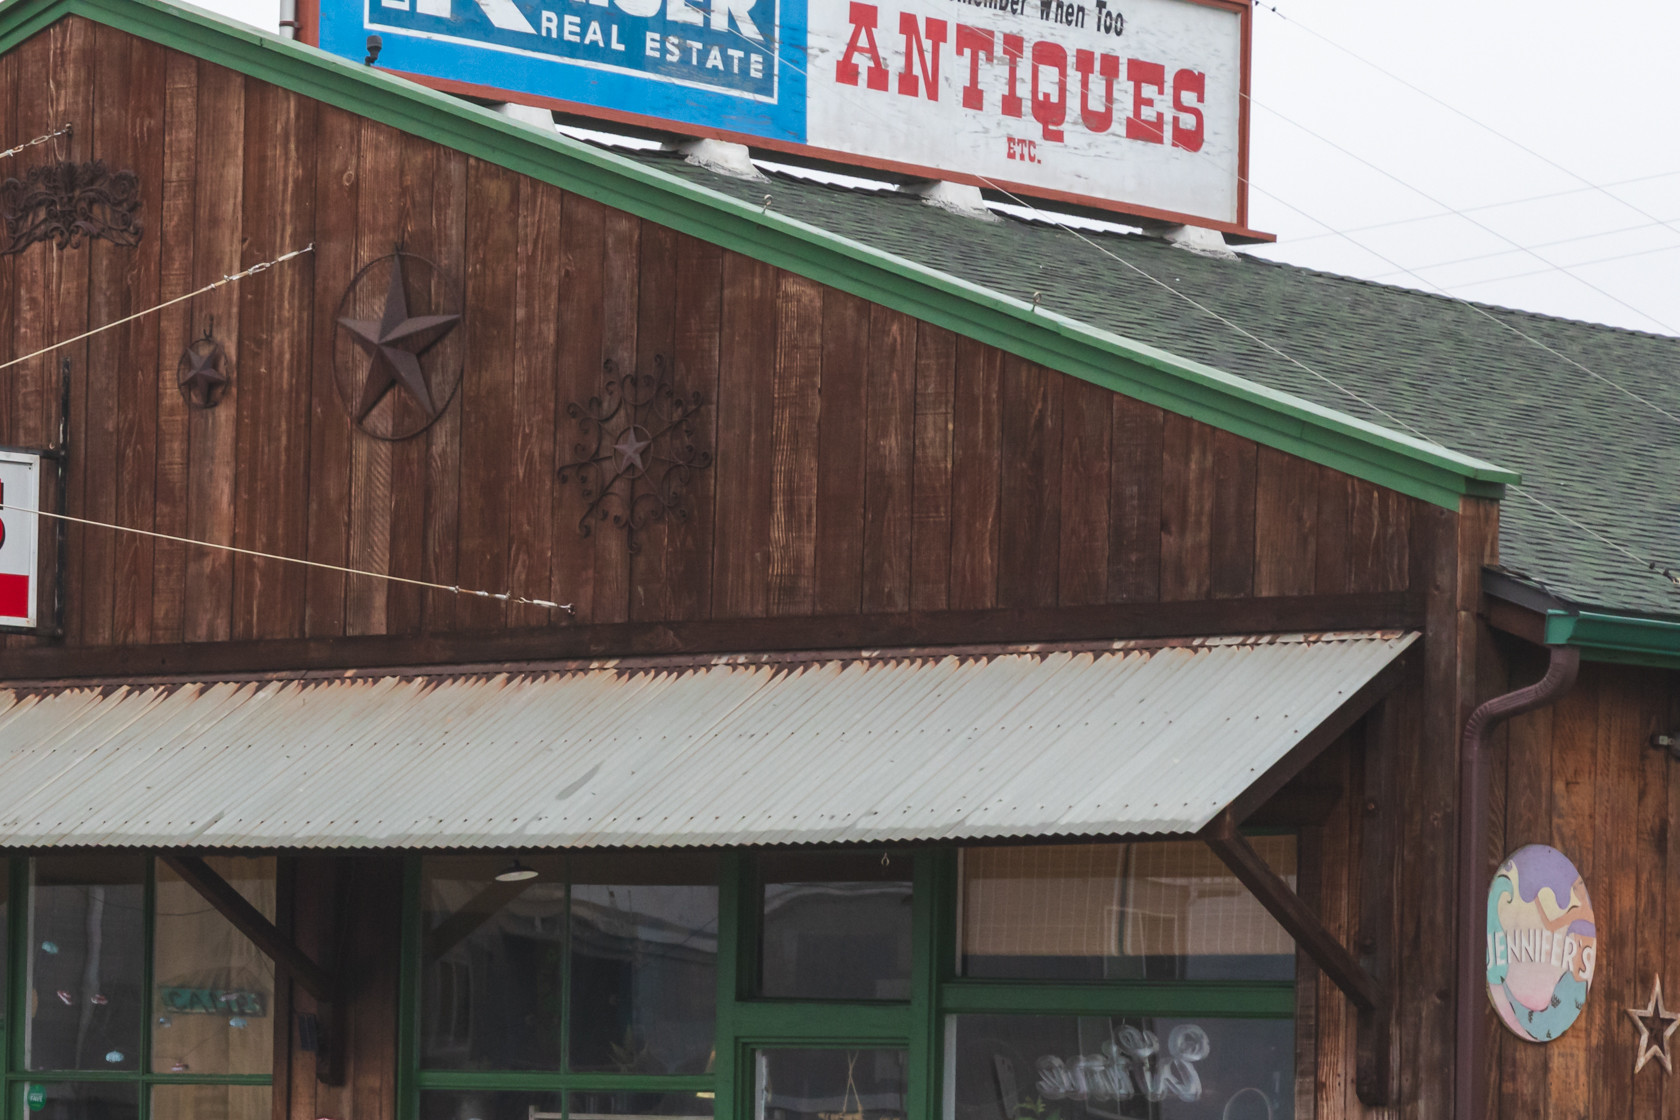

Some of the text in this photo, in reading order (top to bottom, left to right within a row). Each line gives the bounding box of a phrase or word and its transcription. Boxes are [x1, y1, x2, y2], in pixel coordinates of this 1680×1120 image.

[1095, 0, 1124, 36] Too
[541, 10, 626, 51] REAL
[645, 32, 765, 79] ESTATE
[835, 1, 1206, 153] ANTIQUES
[1006, 137, 1042, 164] ETC.
[1486, 928, 1594, 980] JENNIFER'S
